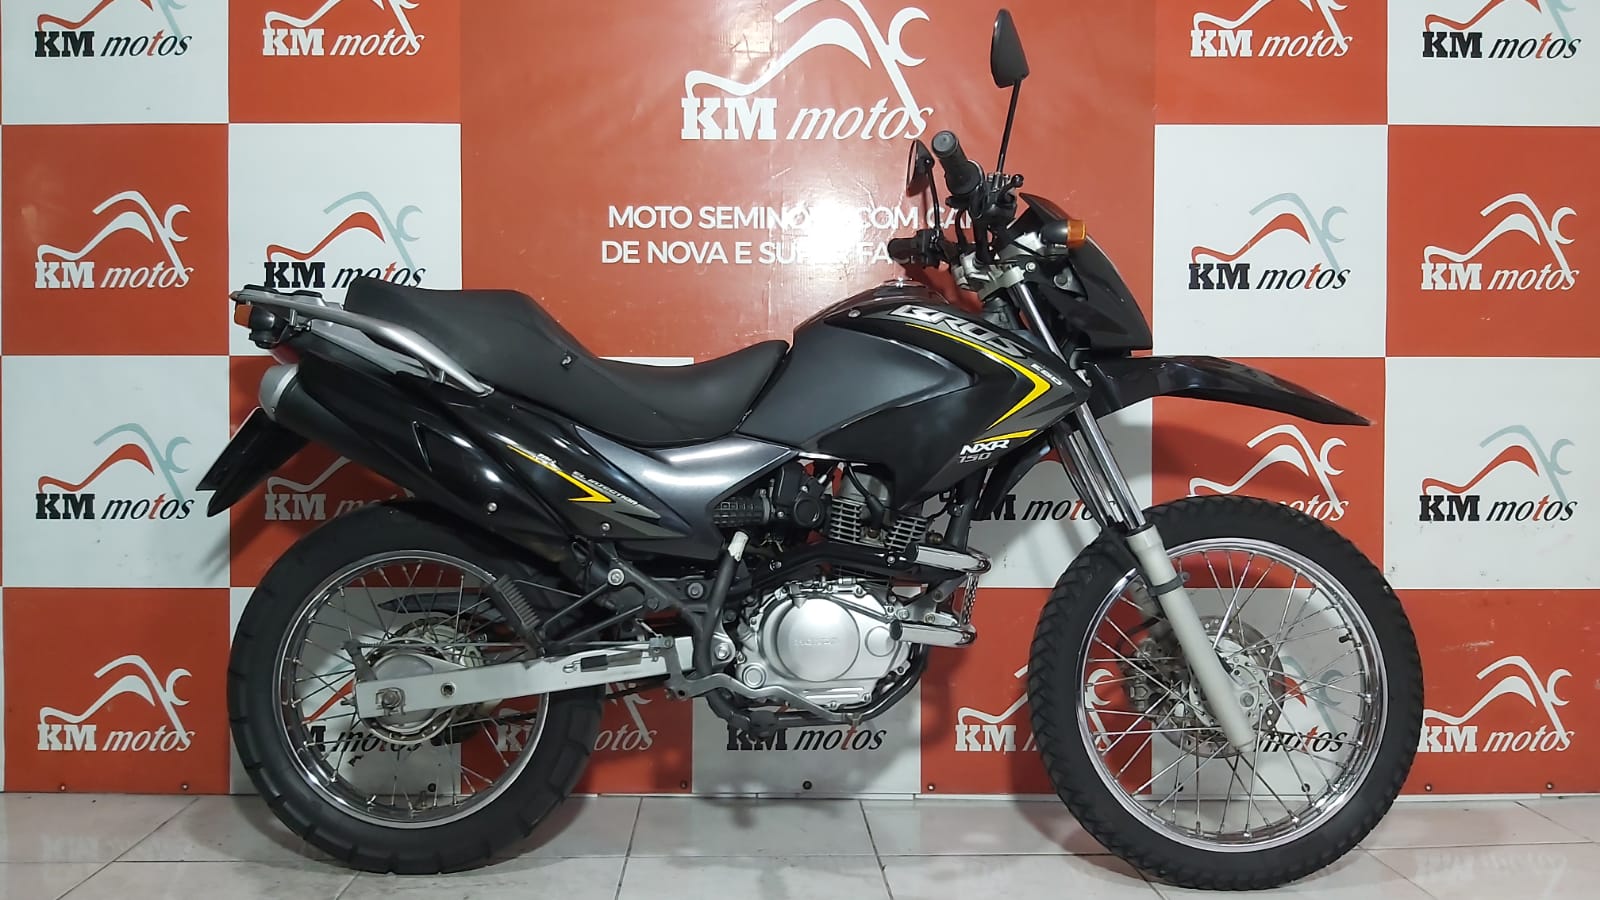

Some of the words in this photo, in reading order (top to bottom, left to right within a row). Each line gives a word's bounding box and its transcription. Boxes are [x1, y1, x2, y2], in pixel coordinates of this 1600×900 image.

[34, 31, 94, 57] KM
[100, 30, 192, 57] motos
[262, 29, 324, 56] KM
[330, 30, 424, 56] motos
[1190, 30, 1252, 57] KM
[1257, 29, 1353, 57] motos
[1422, 31, 1483, 59] KM
[1488, 32, 1582, 59] motos
[681, 97, 777, 140] KM
[786, 97, 934, 140] motos
[608, 205, 693, 229] MOTO
[601, 240, 640, 264] DE
[647, 240, 727, 264] NOVA
[735, 241, 751, 264] E
[35, 262, 95, 289] KM
[100, 261, 194, 289] motos
[264, 262, 325, 288] KM
[1188, 263, 1250, 290] KM
[1255, 263, 1351, 290] motos
[1420, 263, 1482, 290] KM
[1487, 264, 1580, 291] motos
[889, 305, 1035, 358] BROS
[959, 452, 991, 464] 150
[960, 439, 1010, 456] NXR
[35, 493, 96, 520] KM
[100, 493, 195, 520] motos
[264, 493, 327, 521] KM
[984, 494, 1017, 521] M
[1418, 495, 1480, 522] KM
[1485, 495, 1579, 522] motos
[37, 724, 96, 751] KM
[101, 724, 196, 752] motos
[593, 723, 658, 751] otos
[793, 725, 887, 751] motos
[955, 725, 1016, 752] KM
[1417, 725, 1478, 753] KM
[1482, 725, 1576, 753] motos
